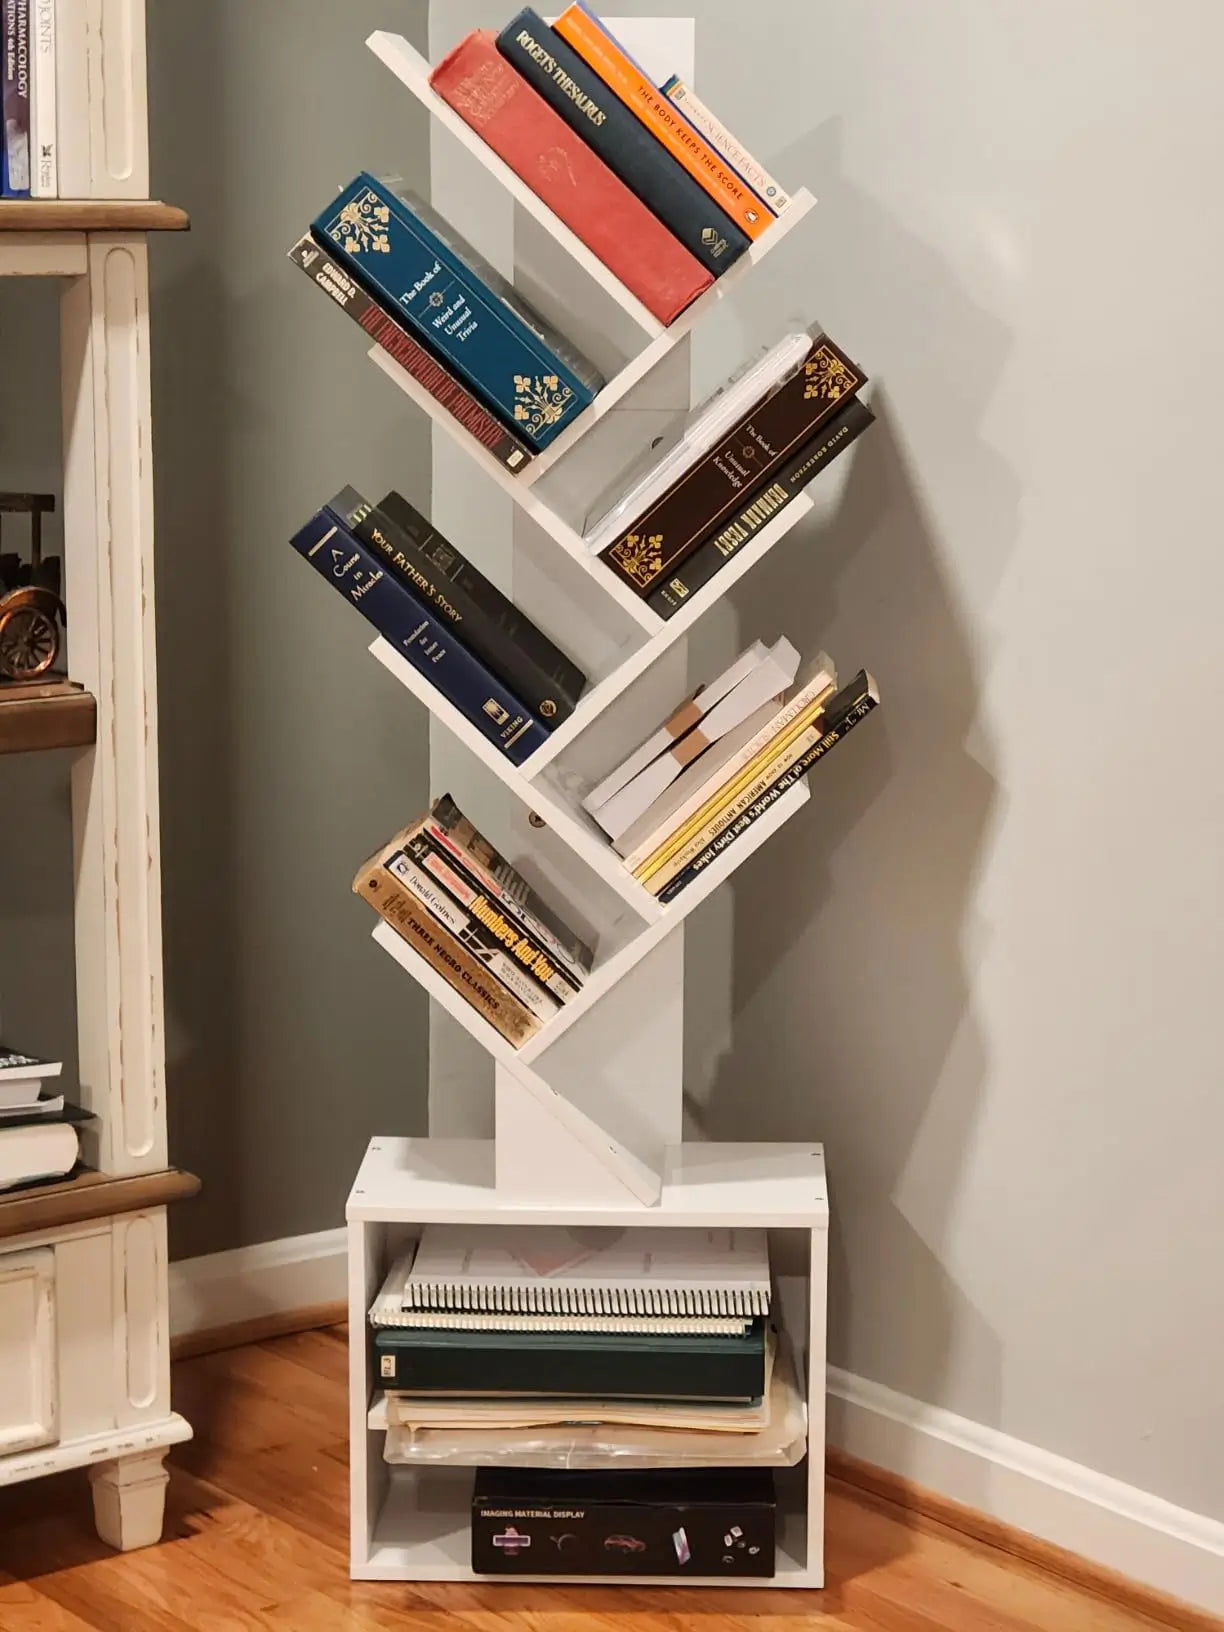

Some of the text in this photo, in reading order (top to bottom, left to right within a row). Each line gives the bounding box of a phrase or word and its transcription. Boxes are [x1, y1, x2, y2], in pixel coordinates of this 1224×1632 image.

[18, 0, 27, 98] HARMACOLOGY
[516, 29, 557, 75] ROGET'S
[551, 65, 607, 127] THESAURUS
[636, 86, 652, 102] THE
[652, 104, 675, 126] BODY
[675, 128, 700, 154] KEEPS
[700, 154, 716, 171] THE
[716, 172, 743, 199] SCORE
[314, 271, 349, 305] CAMPBELL
[321, 262, 358, 298] EDWARD D.
[400, 261, 442, 304] The Book of
[431, 294, 465, 328] Weird and
[443, 306, 472, 335] Unusual
[455, 319, 478, 341] Trivia
[744, 423, 777, 456] The Book of
[789, 426, 848, 482] DAVID ROBERTSON
[712, 455, 743, 489] Knowledge
[724, 450, 750, 477] Unusual
[712, 482, 788, 556] DENMARK VESEY
[330, 548, 344, 562] A
[333, 552, 360, 578] Course
[350, 570, 384, 600] Miracles
[352, 570, 362, 580] in
[368, 528, 463, 623] YOUR FATHER'S STORY
[854, 702, 869, 717] Mr.
[500, 716, 524, 739] VIKING
[821, 731, 839, 748] Still
[792, 764, 804, 776] of
[800, 745, 824, 767] More
[735, 780, 767, 809] AMERICAN
[777, 774, 795, 791] The
[748, 788, 780, 819] World's
[707, 808, 737, 835] ANTIQUES
[731, 815, 751, 834] Best
[712, 830, 735, 852] Dirty
[691, 847, 716, 872] Jokes
[409, 876, 433, 902] Donald
[430, 897, 456, 925] Goines
[468, 894, 556, 981] Numbers And You
[406, 918, 435, 945] THREE
[432, 943, 463, 972] NEGRO
[460, 971, 500, 1009] CLASSICS
[480, 1510, 584, 1519] IMAGING MATERIAL DISPLAY
